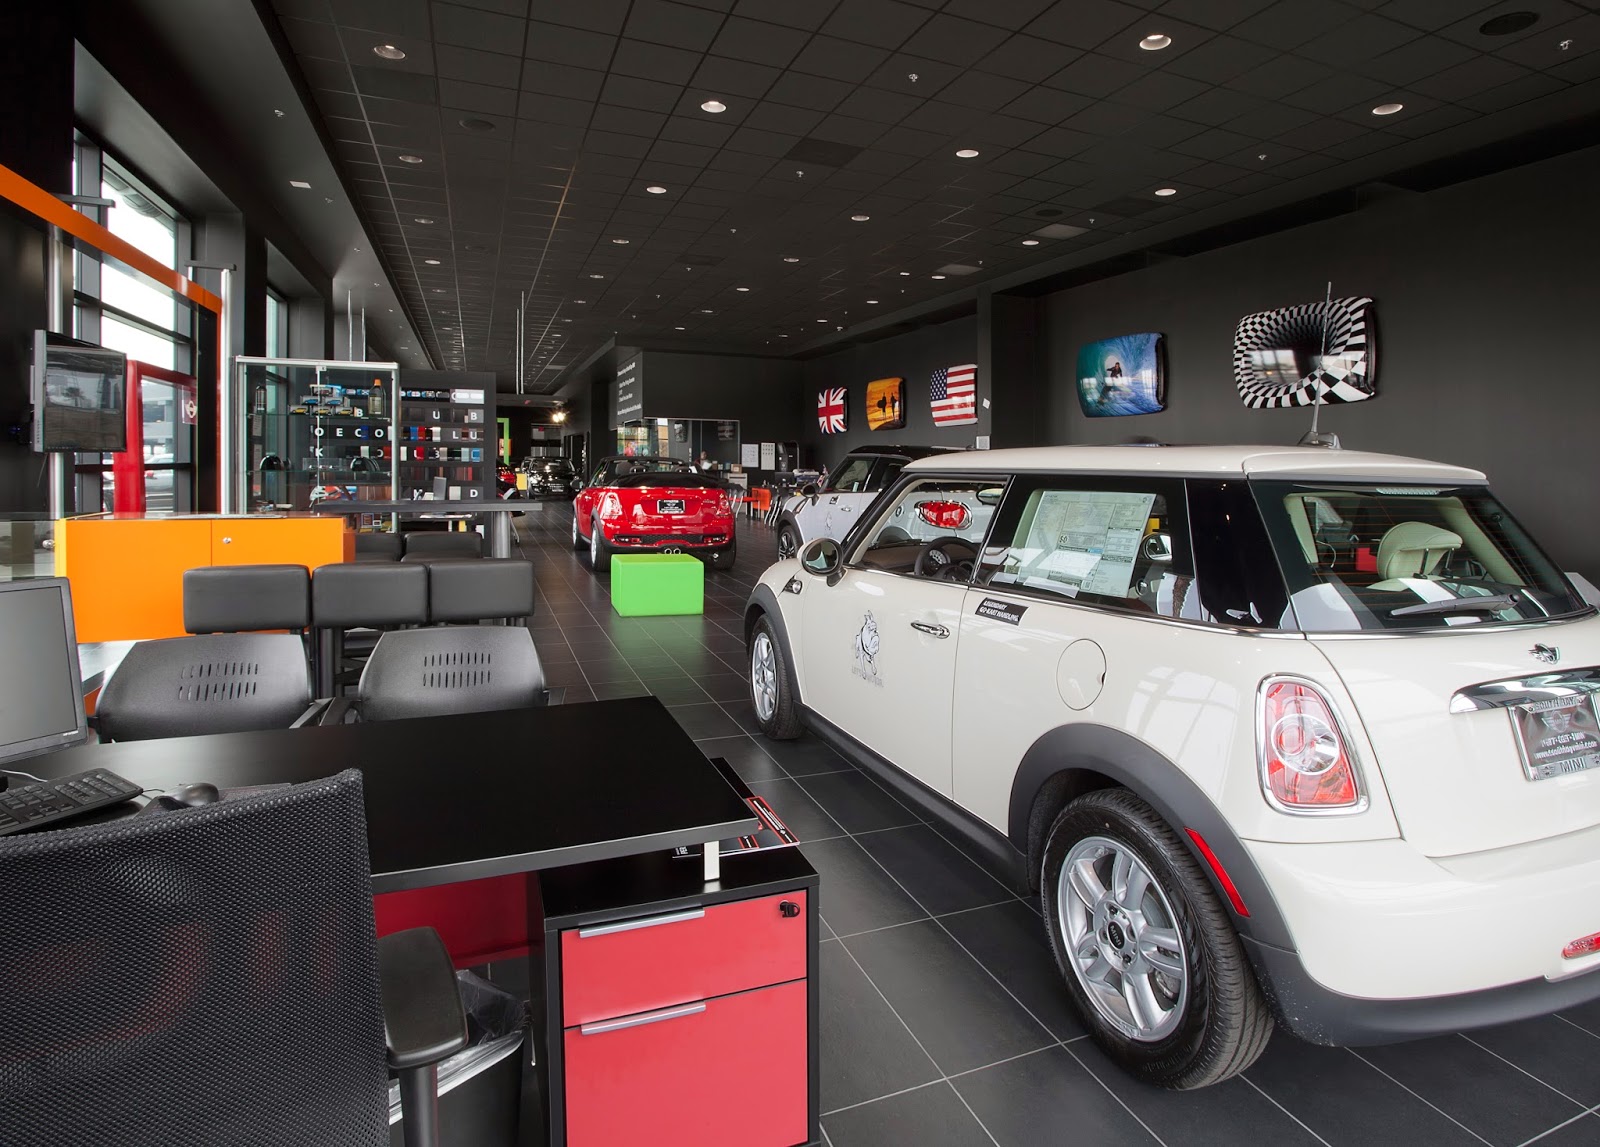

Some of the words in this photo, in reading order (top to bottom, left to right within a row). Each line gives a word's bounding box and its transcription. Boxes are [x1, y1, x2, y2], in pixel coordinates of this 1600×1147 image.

[432, 410, 441, 420] U
[470, 412, 478, 421] B
[336, 427, 344, 437] E
[374, 428, 384, 438] O
[452, 431, 460, 440] L
[469, 431, 478, 440] U
[469, 489, 479, 498] D
[1560, 757, 1586, 773] MINI
[1110, 926, 1122, 946] MINI
